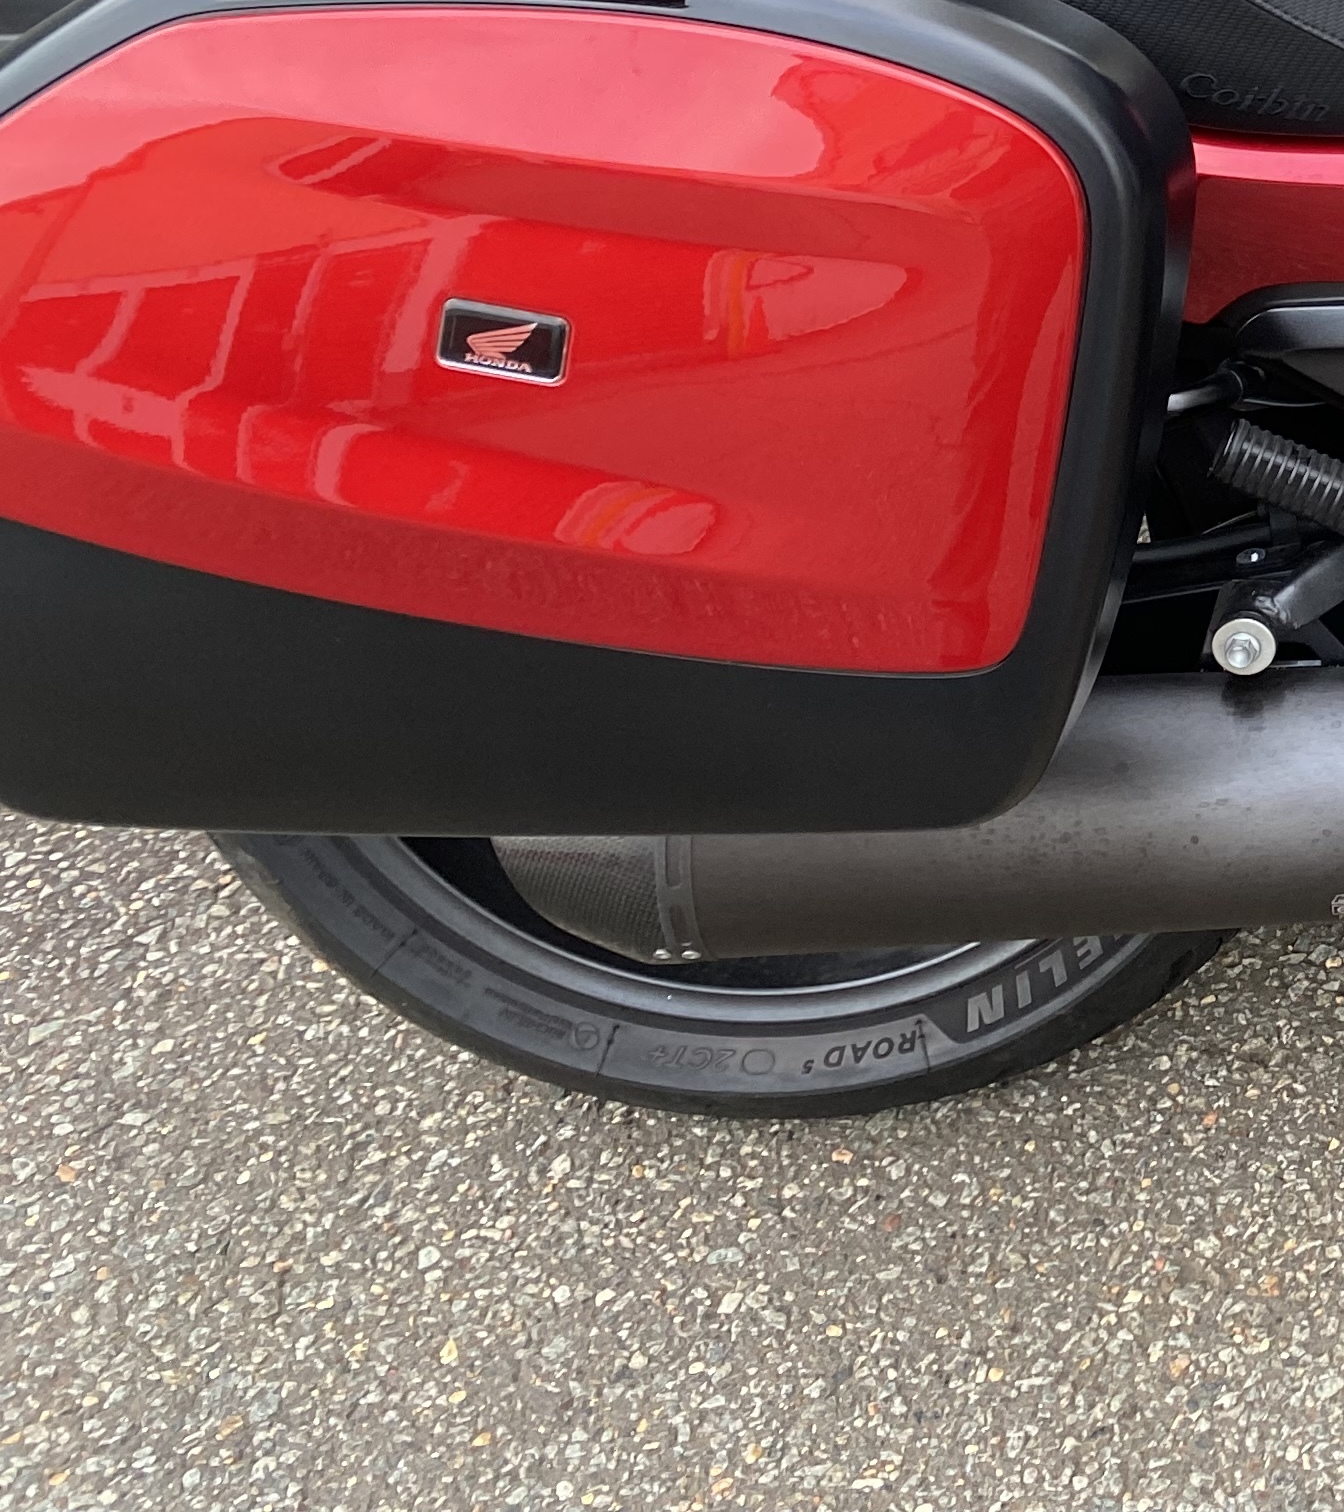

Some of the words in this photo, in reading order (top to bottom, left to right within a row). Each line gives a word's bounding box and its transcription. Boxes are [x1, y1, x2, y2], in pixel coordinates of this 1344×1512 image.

[1179, 72, 1331, 122] Corbin
[463, 352, 533, 373] HONDA
[823, 1029, 918, 1069] ROAD
